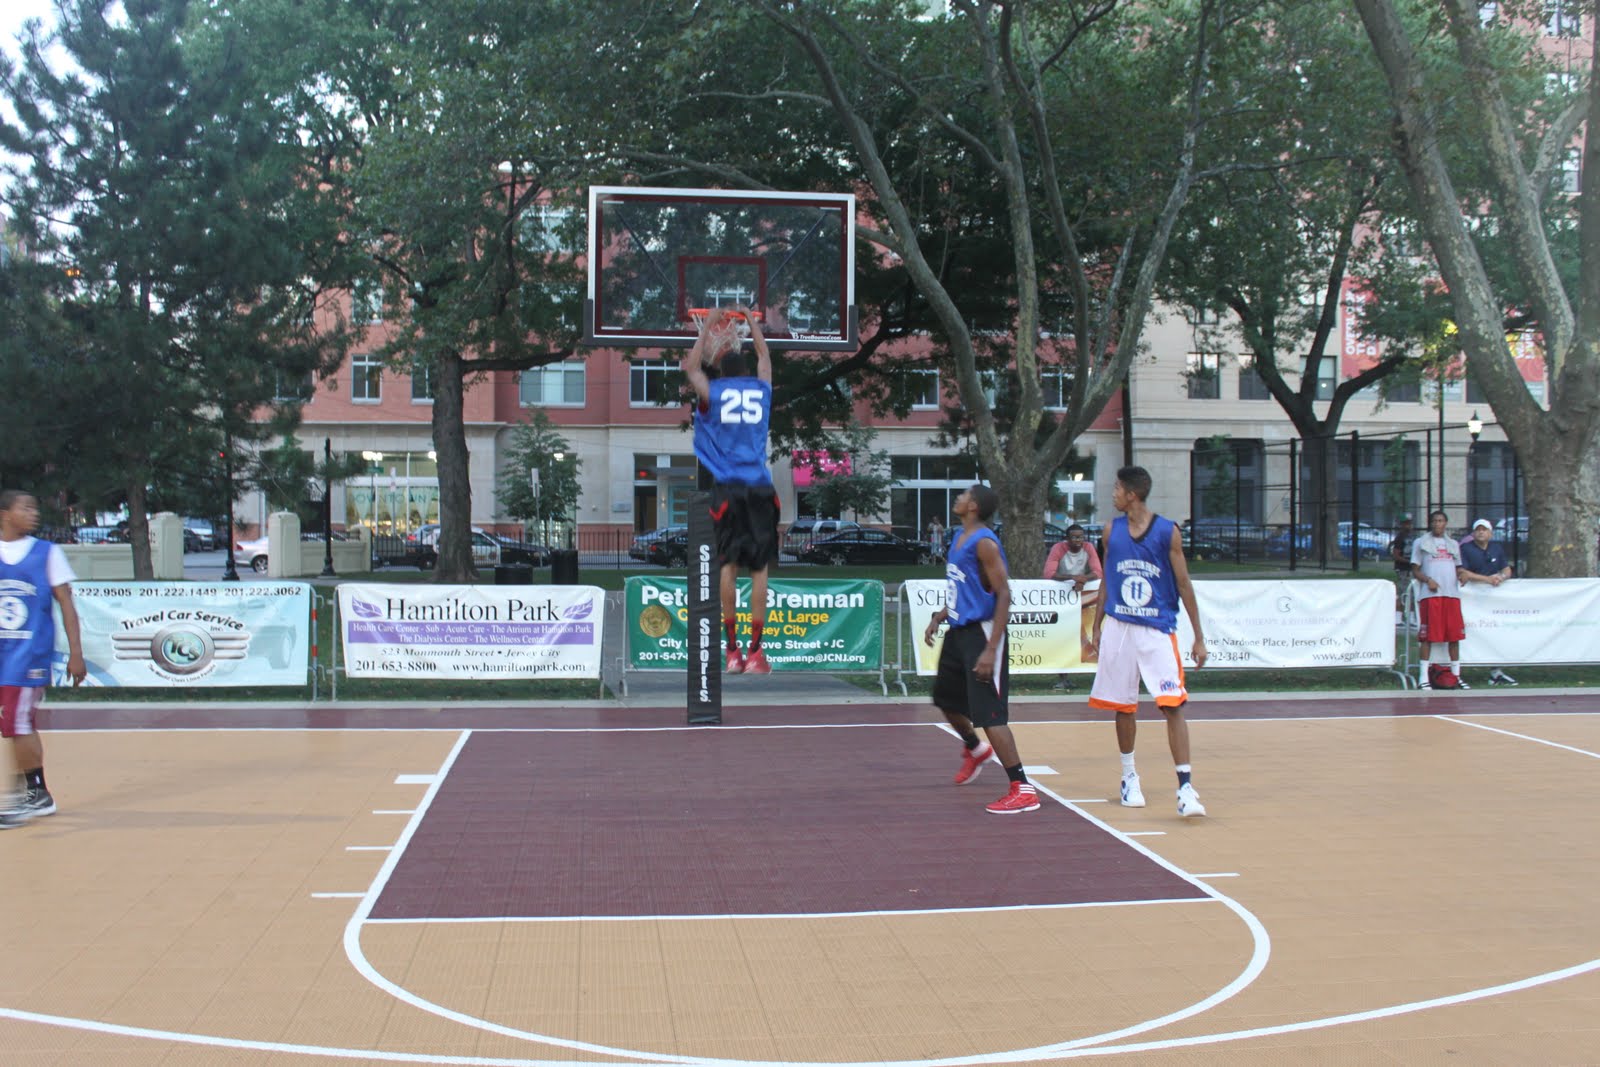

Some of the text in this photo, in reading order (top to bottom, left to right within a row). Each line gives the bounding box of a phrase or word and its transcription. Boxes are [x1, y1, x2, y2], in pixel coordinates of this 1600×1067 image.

[720, 388, 763, 424] 25
[700, 544, 710, 602] Snap
[75, 586, 302, 597] .222.9505 201.222.1449 201.222.3062
[642, 585, 688, 606] Pet
[766, 588, 864, 608] Brennan
[1130, 581, 1142, 600] 11
[1022, 590, 1078, 606] SCERBO
[387, 598, 560, 621] Hamilton Park
[1114, 604, 1158, 617] RECREATION
[121, 610, 244, 630] Travel Car Service
[768, 610, 784, 622] At
[788, 610, 829, 624] Large
[1009, 613, 1053, 624] AT LAW
[353, 622, 376, 632] Health
[378, 624, 394, 632] Care
[396, 624, 419, 632] Center
[426, 624, 440, 632] Sub
[446, 624, 466, 632] Acute
[468, 624, 484, 632] Care
[492, 625, 504, 633] The
[506, 624, 532, 633] Atrium
[542, 625, 574, 633] Hamilton
[575, 624, 591, 632] Park
[741, 624, 780, 636] Jesey
[784, 624, 806, 636] City
[400, 634, 545, 644] The Dialysis Center The Wellness Center
[659, 638, 682, 649] City
[720, 640, 744, 649] 20
[785, 640, 821, 649] Street
[831, 640, 844, 648] JC
[1262, 638, 1289, 648] Place,
[1292, 638, 1317, 648] Jersey
[1343, 637, 1356, 646] NJ
[381, 648, 561, 657] 523 Monmouth Street Jersey City
[639, 652, 866, 664] 201-547- brennanp@JCNJ.org
[356, 660, 586, 674] 201-653-8800 www.hamiltonpark.com
